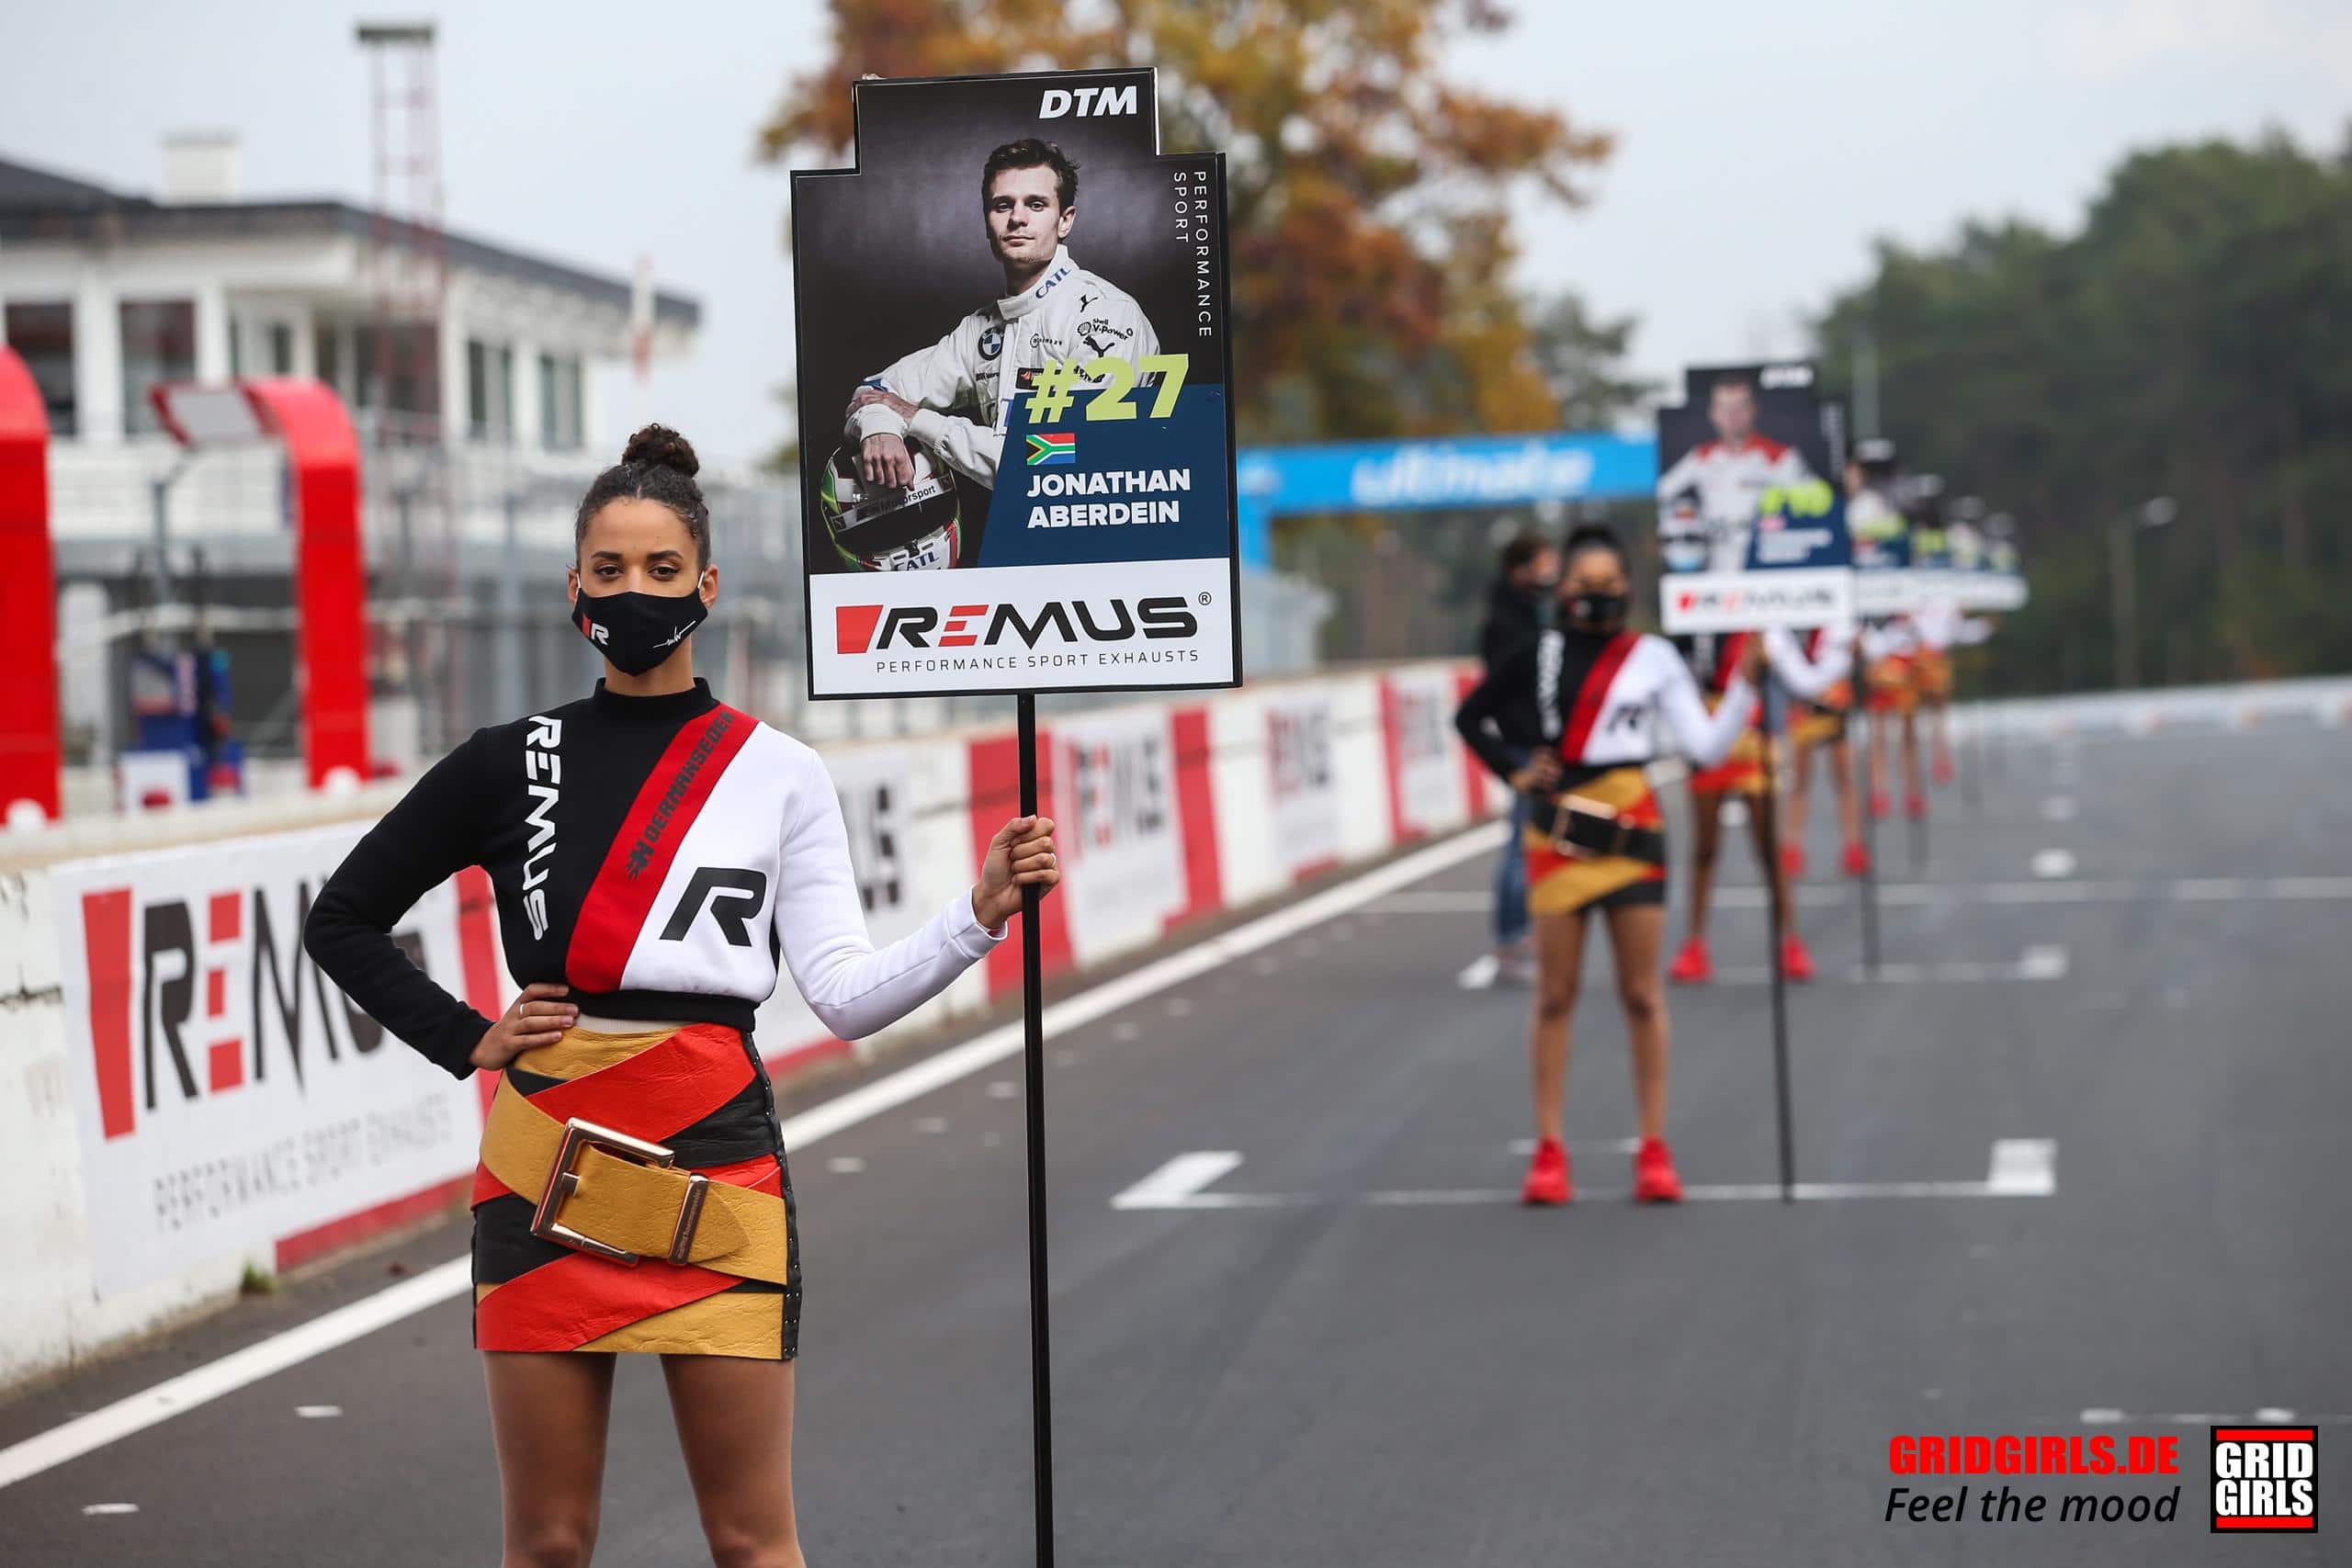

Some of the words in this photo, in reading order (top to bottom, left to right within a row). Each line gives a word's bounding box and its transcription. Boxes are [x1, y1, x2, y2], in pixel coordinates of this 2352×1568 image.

[1038, 85, 1138, 119] DTM
[1173, 172, 1189, 243] SPORT
[1035, 266, 1071, 299] CATL
[1193, 171, 1212, 337] PERFORMANCE
[1024, 353, 1189, 423] #27
[1026, 468, 1191, 498] JONATHAN
[1027, 501, 1180, 529] ABERDEIN
[876, 656, 1017, 673] PERFORMANCE
[1027, 654, 1089, 668] SPORT
[1099, 650, 1198, 665] EXHAUSTS
[522, 715, 562, 941] REMUS
[659, 866, 768, 948] R
[142, 877, 428, 1111] REM
